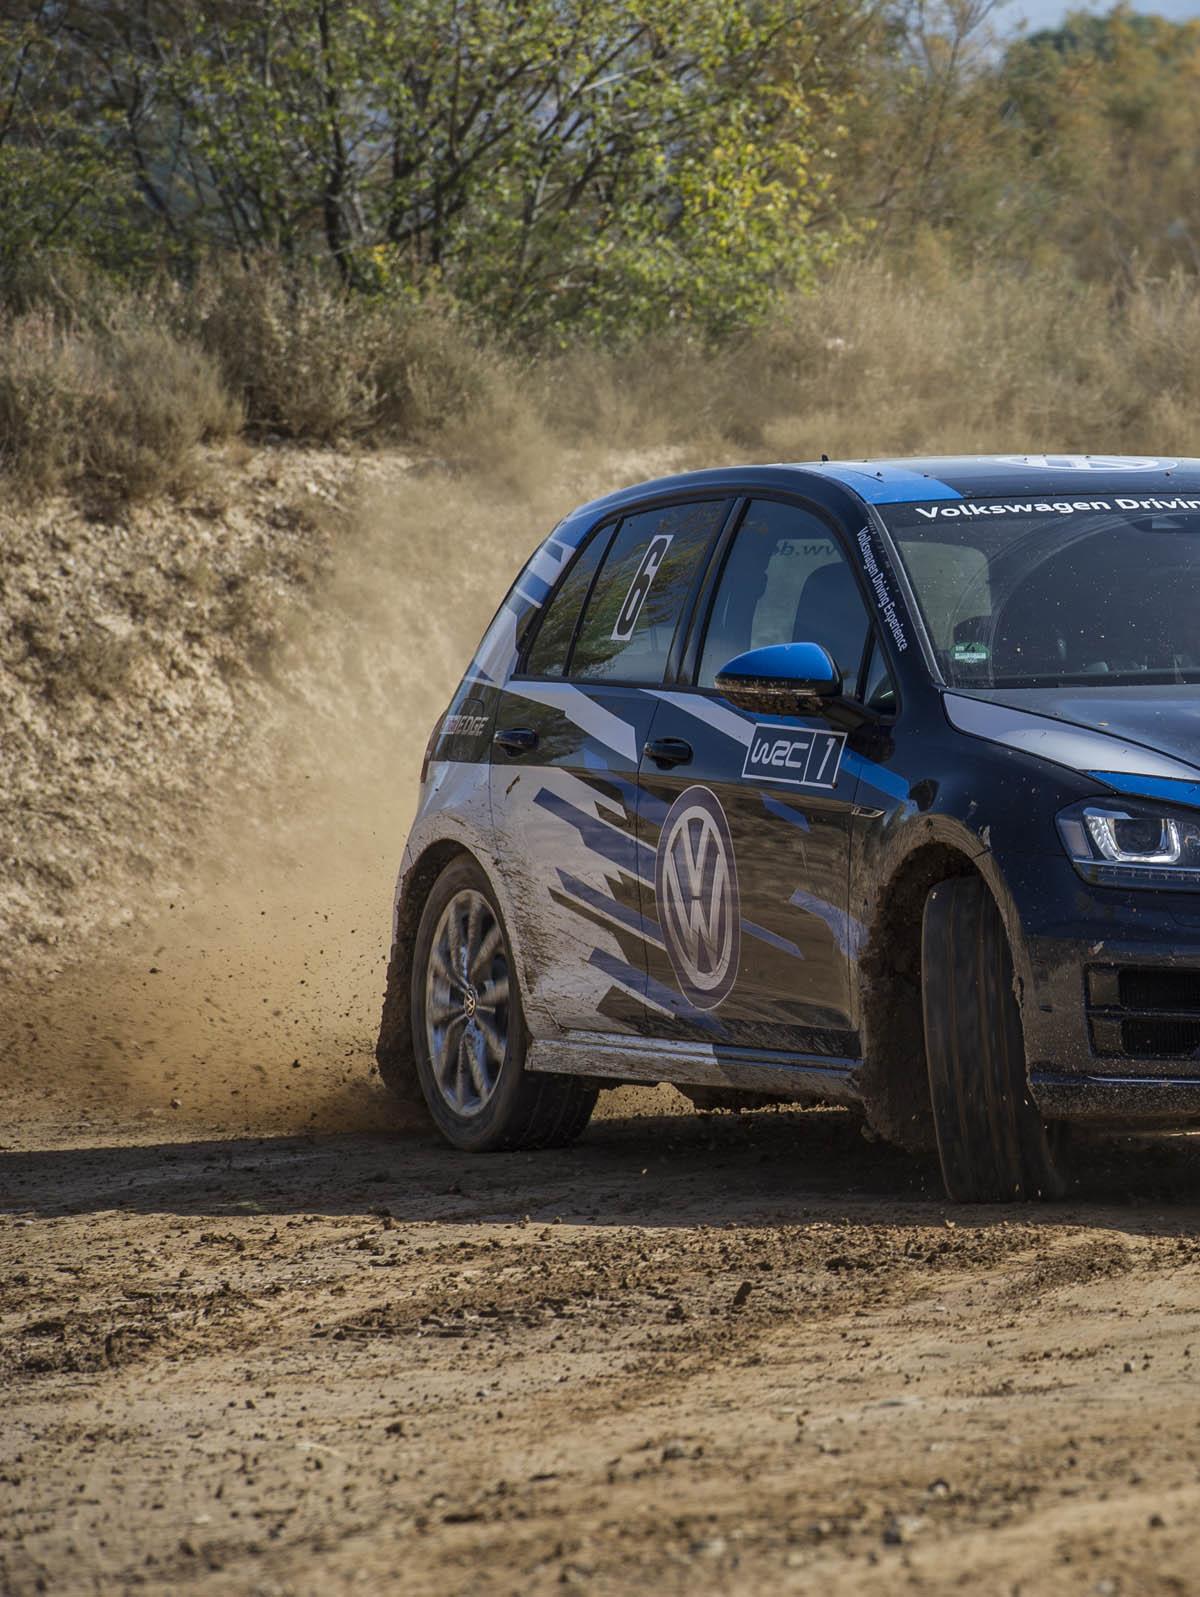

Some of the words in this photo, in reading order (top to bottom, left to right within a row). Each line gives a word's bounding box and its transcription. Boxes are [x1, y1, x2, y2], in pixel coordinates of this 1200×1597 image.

[915, 499, 1112, 519] Volkswagen
[616, 537, 668, 636] 6
[856, 526, 879, 577] Volkswagen
[871, 572, 890, 608] Driving
[883, 601, 908, 652] Experience
[751, 738, 809, 768] WRC
[816, 738, 836, 780] 1
